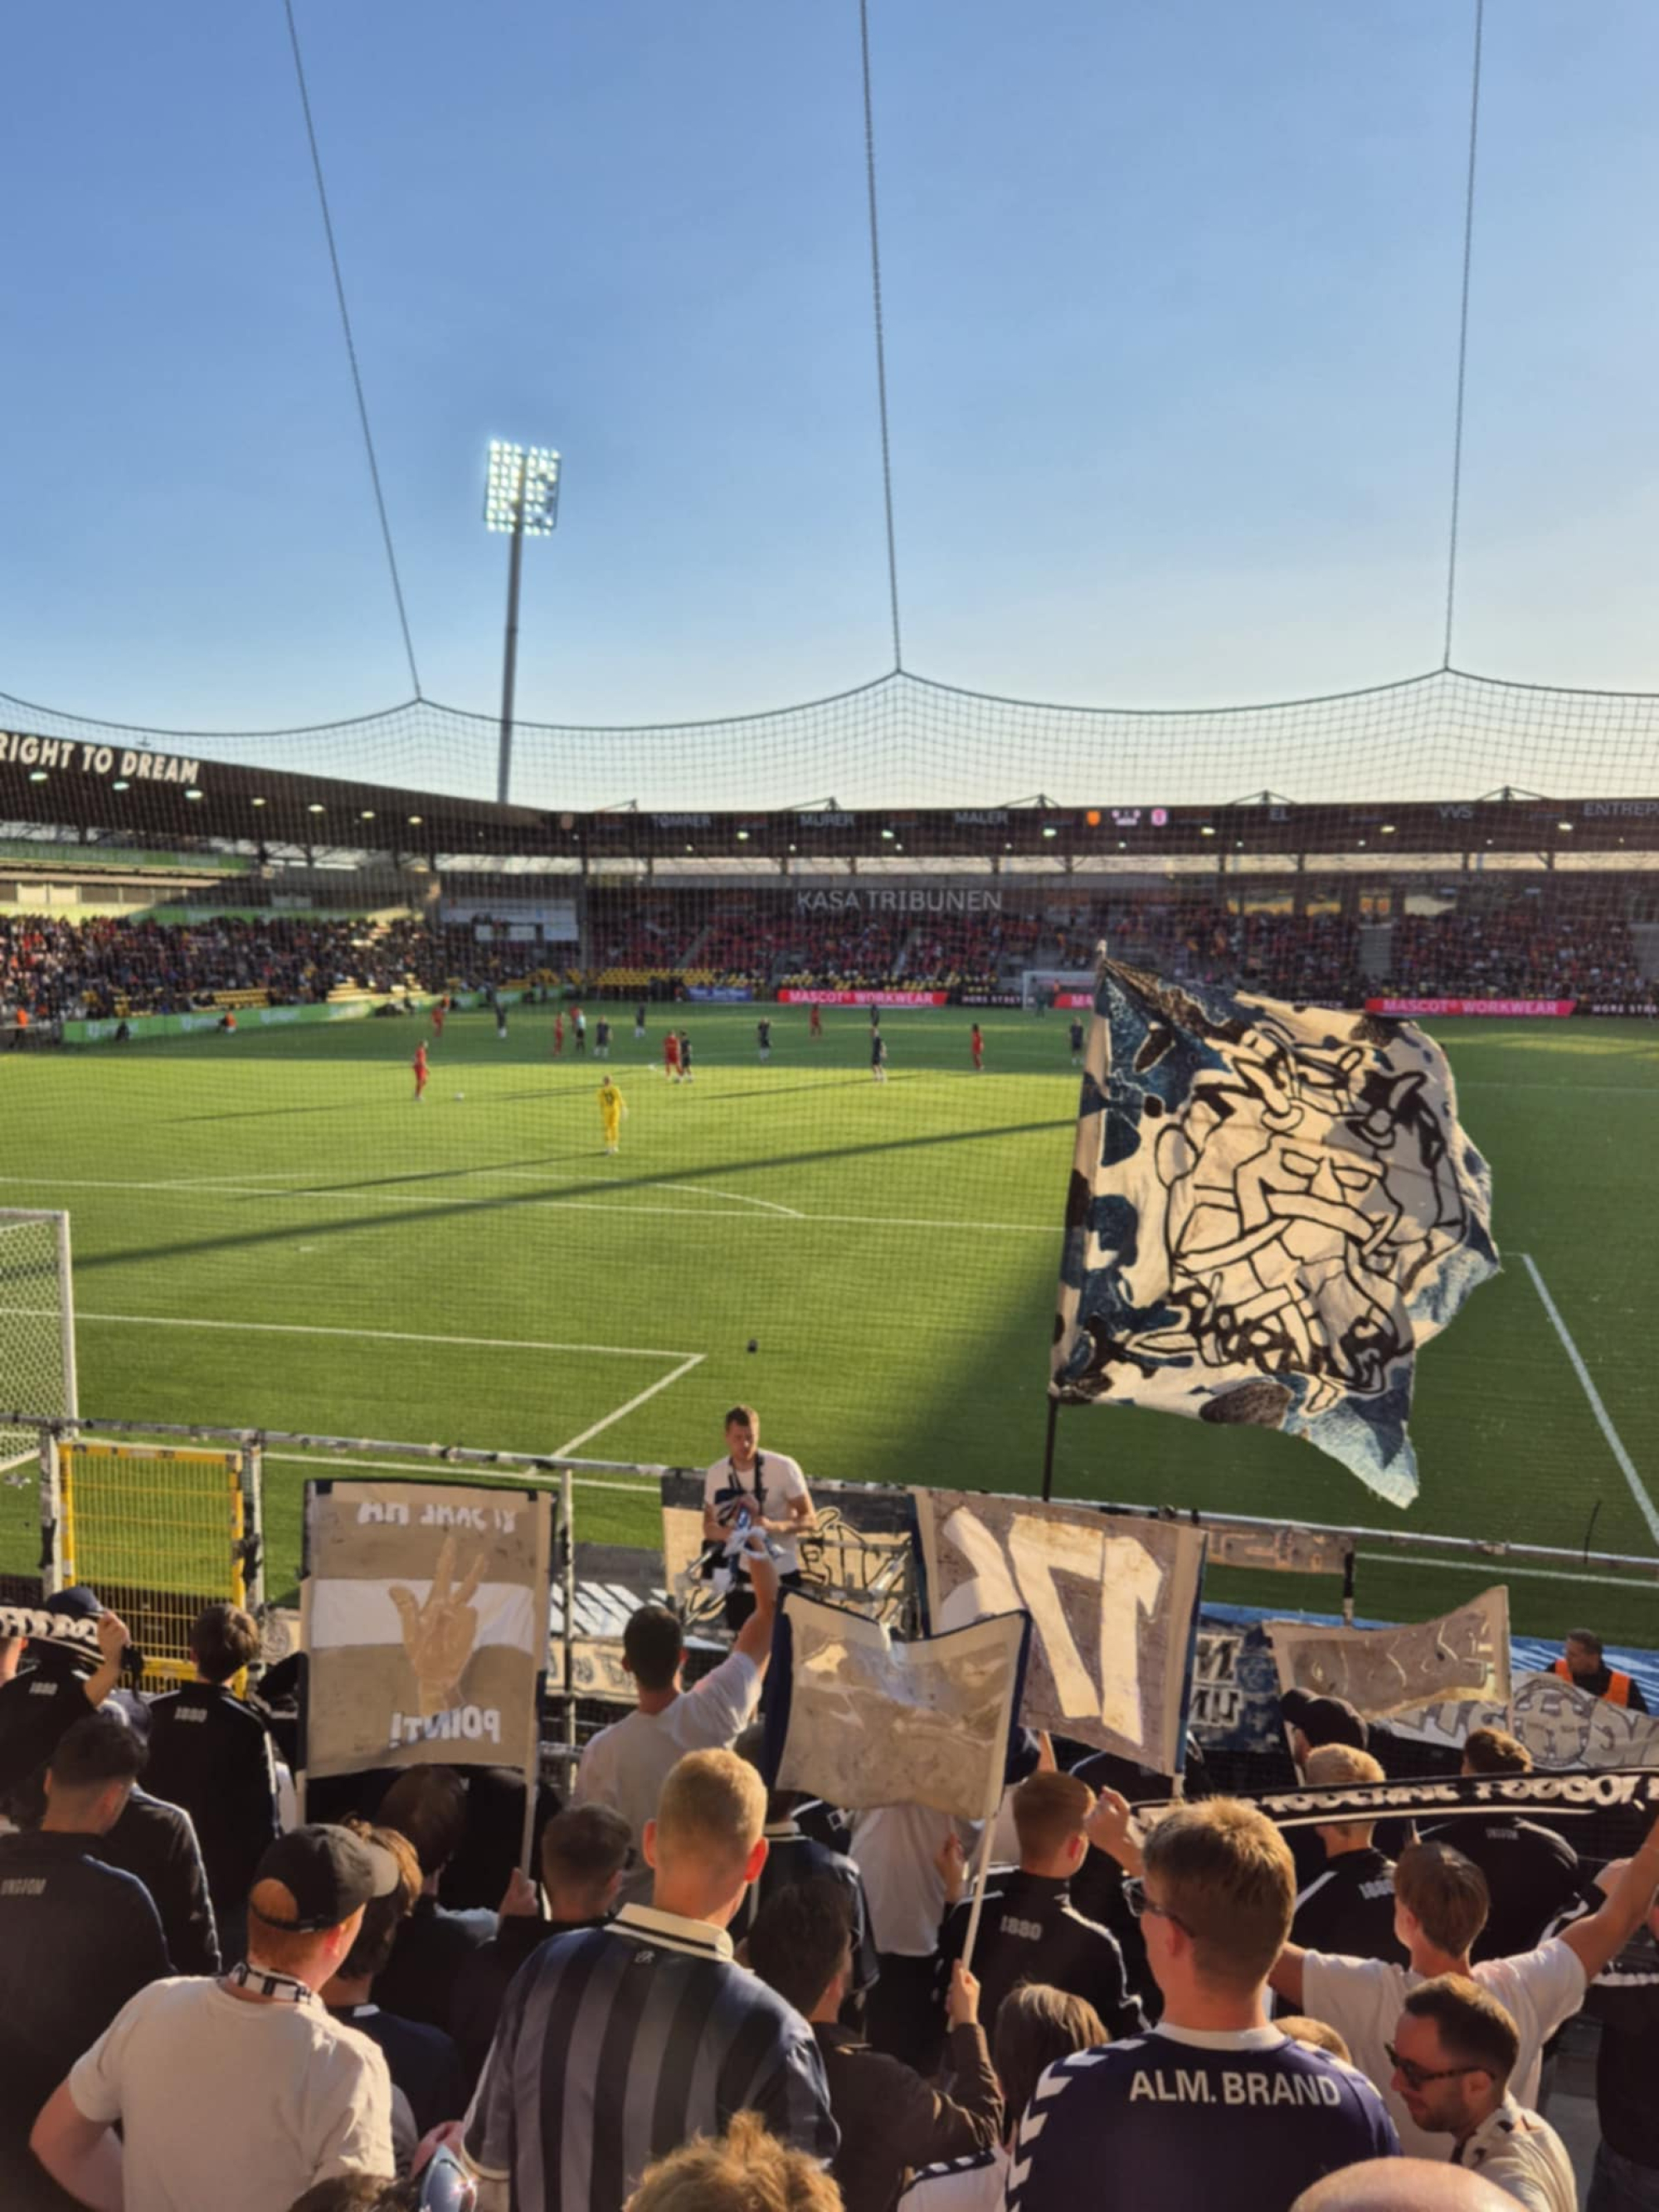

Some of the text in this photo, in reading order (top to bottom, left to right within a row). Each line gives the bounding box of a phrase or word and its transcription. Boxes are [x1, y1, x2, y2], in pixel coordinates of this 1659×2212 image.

[82, 745, 114, 774] TO
[119, 751, 200, 784] DREAM
[954, 810, 1009, 824] MALER
[1438, 804, 1473, 819] VVS
[800, 814, 855, 828] MURER
[797, 889, 1002, 912] KASA TRIBUNEN
[854, 991, 934, 1005] WORKWEAR
[1462, 1000, 1557, 1014] WORKWEAR
[1129, 2069, 1342, 2106] ALM. BRAND
